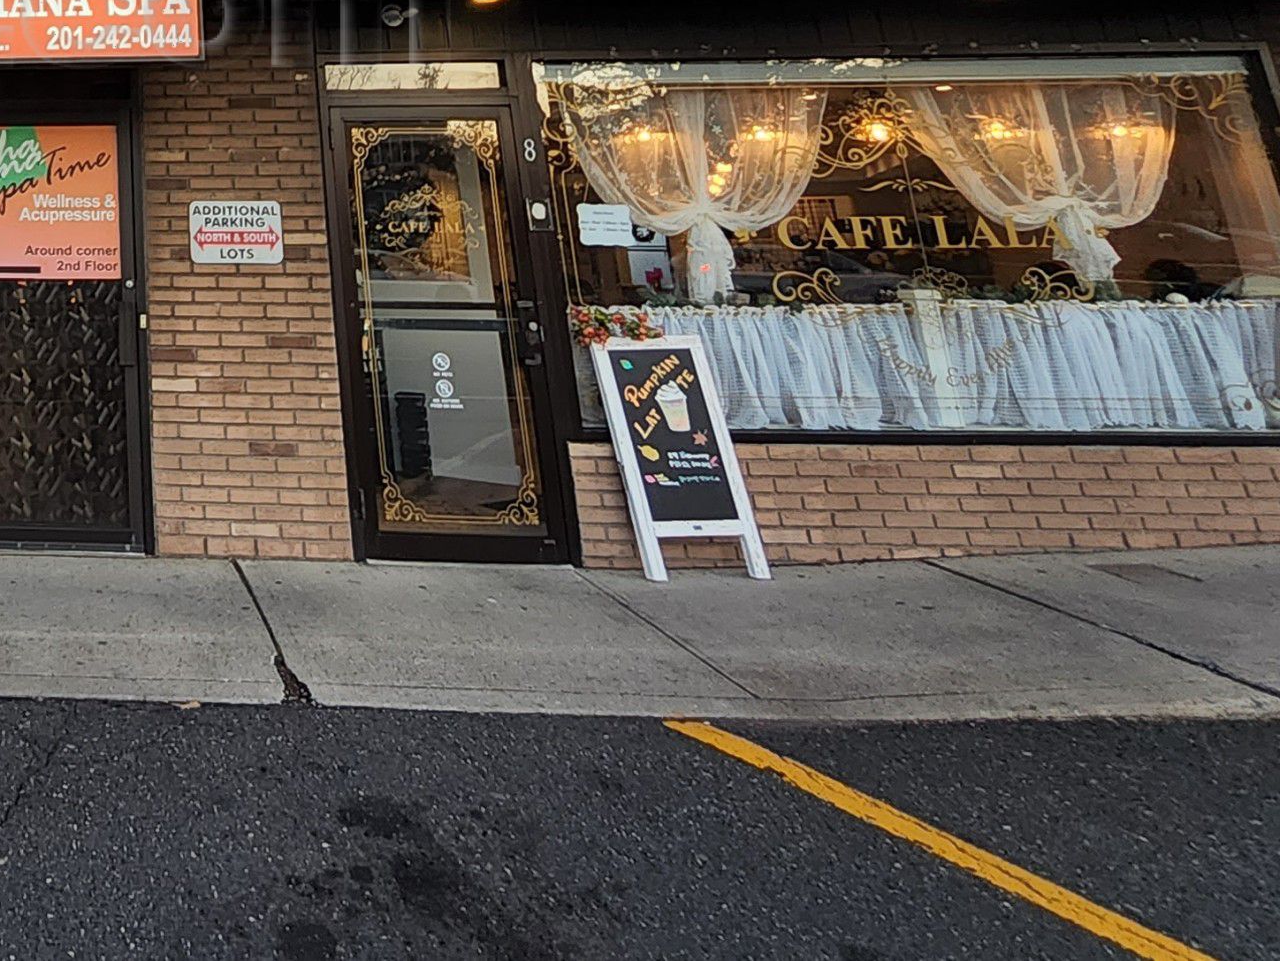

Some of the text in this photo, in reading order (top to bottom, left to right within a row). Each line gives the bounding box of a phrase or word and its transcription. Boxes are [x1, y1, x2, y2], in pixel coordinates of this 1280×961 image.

[46, 23, 193, 50] 201-242-0444
[524, 138, 536, 161] 8
[37, 146, 111, 185] Time
[32, 193, 116, 208] Wellness &
[18, 207, 116, 225] Acupressure
[192, 205, 278, 216] ADDITIONAL
[204, 217, 266, 228] PARKING
[388, 221, 429, 234] CAFE
[197, 233, 276, 243] NORTH & SOUTH
[777, 214, 1073, 250] CAFE LALA
[24, 245, 118, 256] Around corner
[220, 248, 255, 259] LOTS
[57, 260, 118, 271] 2nd Floor
[633, 408, 662, 440] LAT
